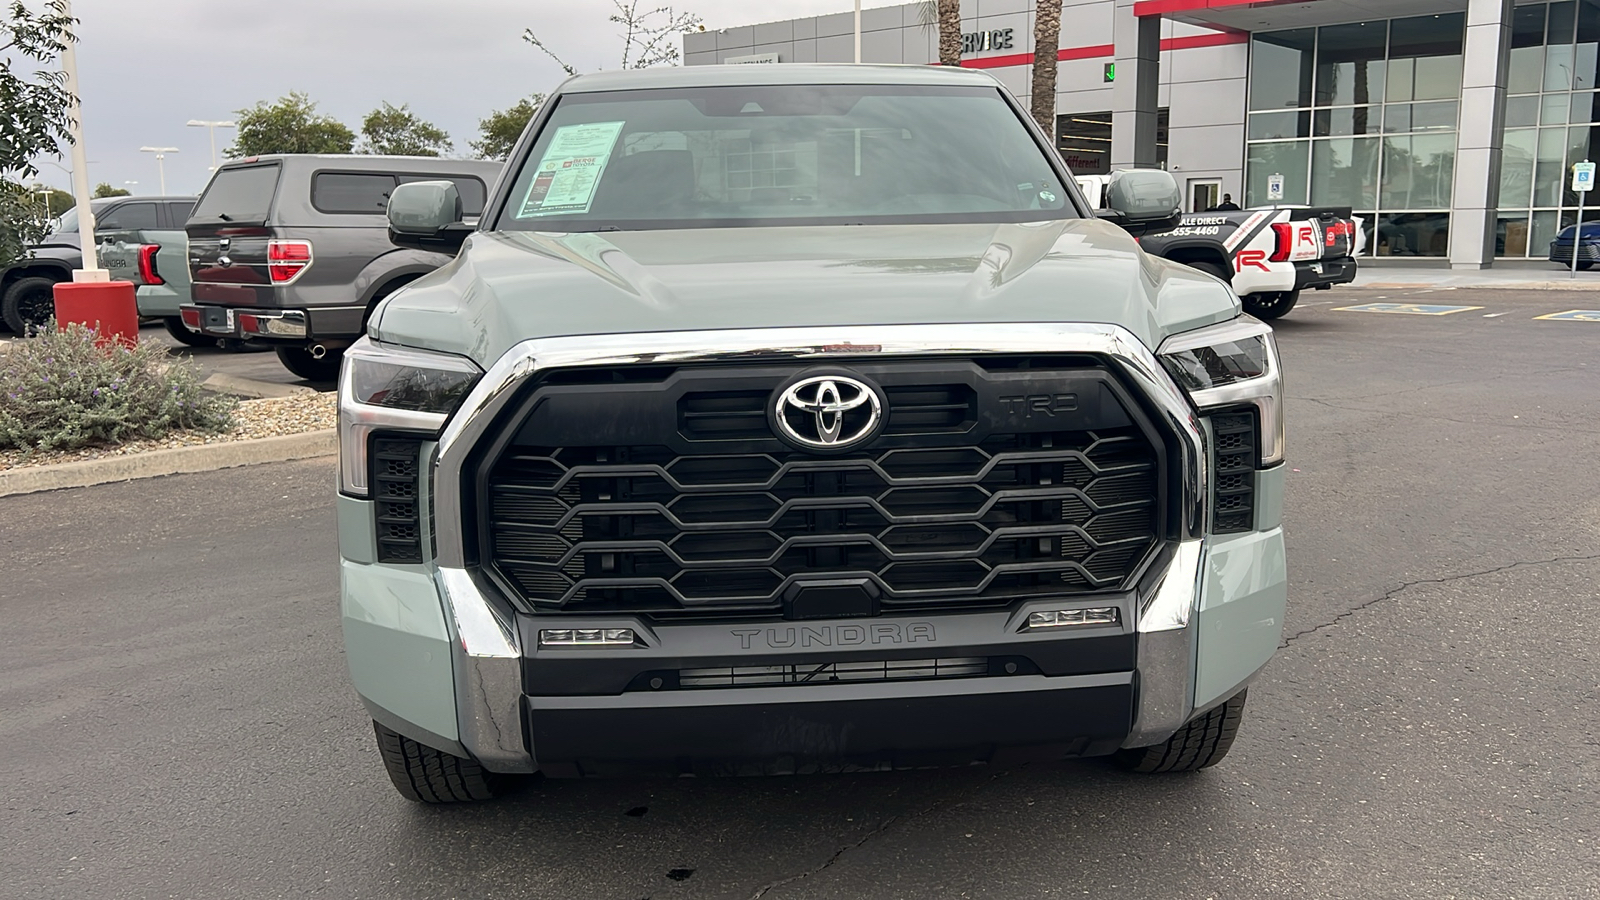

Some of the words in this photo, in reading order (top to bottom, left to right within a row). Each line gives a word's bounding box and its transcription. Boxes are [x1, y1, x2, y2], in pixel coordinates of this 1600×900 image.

[960, 28, 1014, 53] RVICE
[1154, 226, 1220, 240] -655-4460
[1181, 218, 1196, 227] ALE
[1197, 217, 1228, 226] DIRECT
[999, 393, 1079, 419] TRD
[729, 621, 938, 650] TUNDRA
